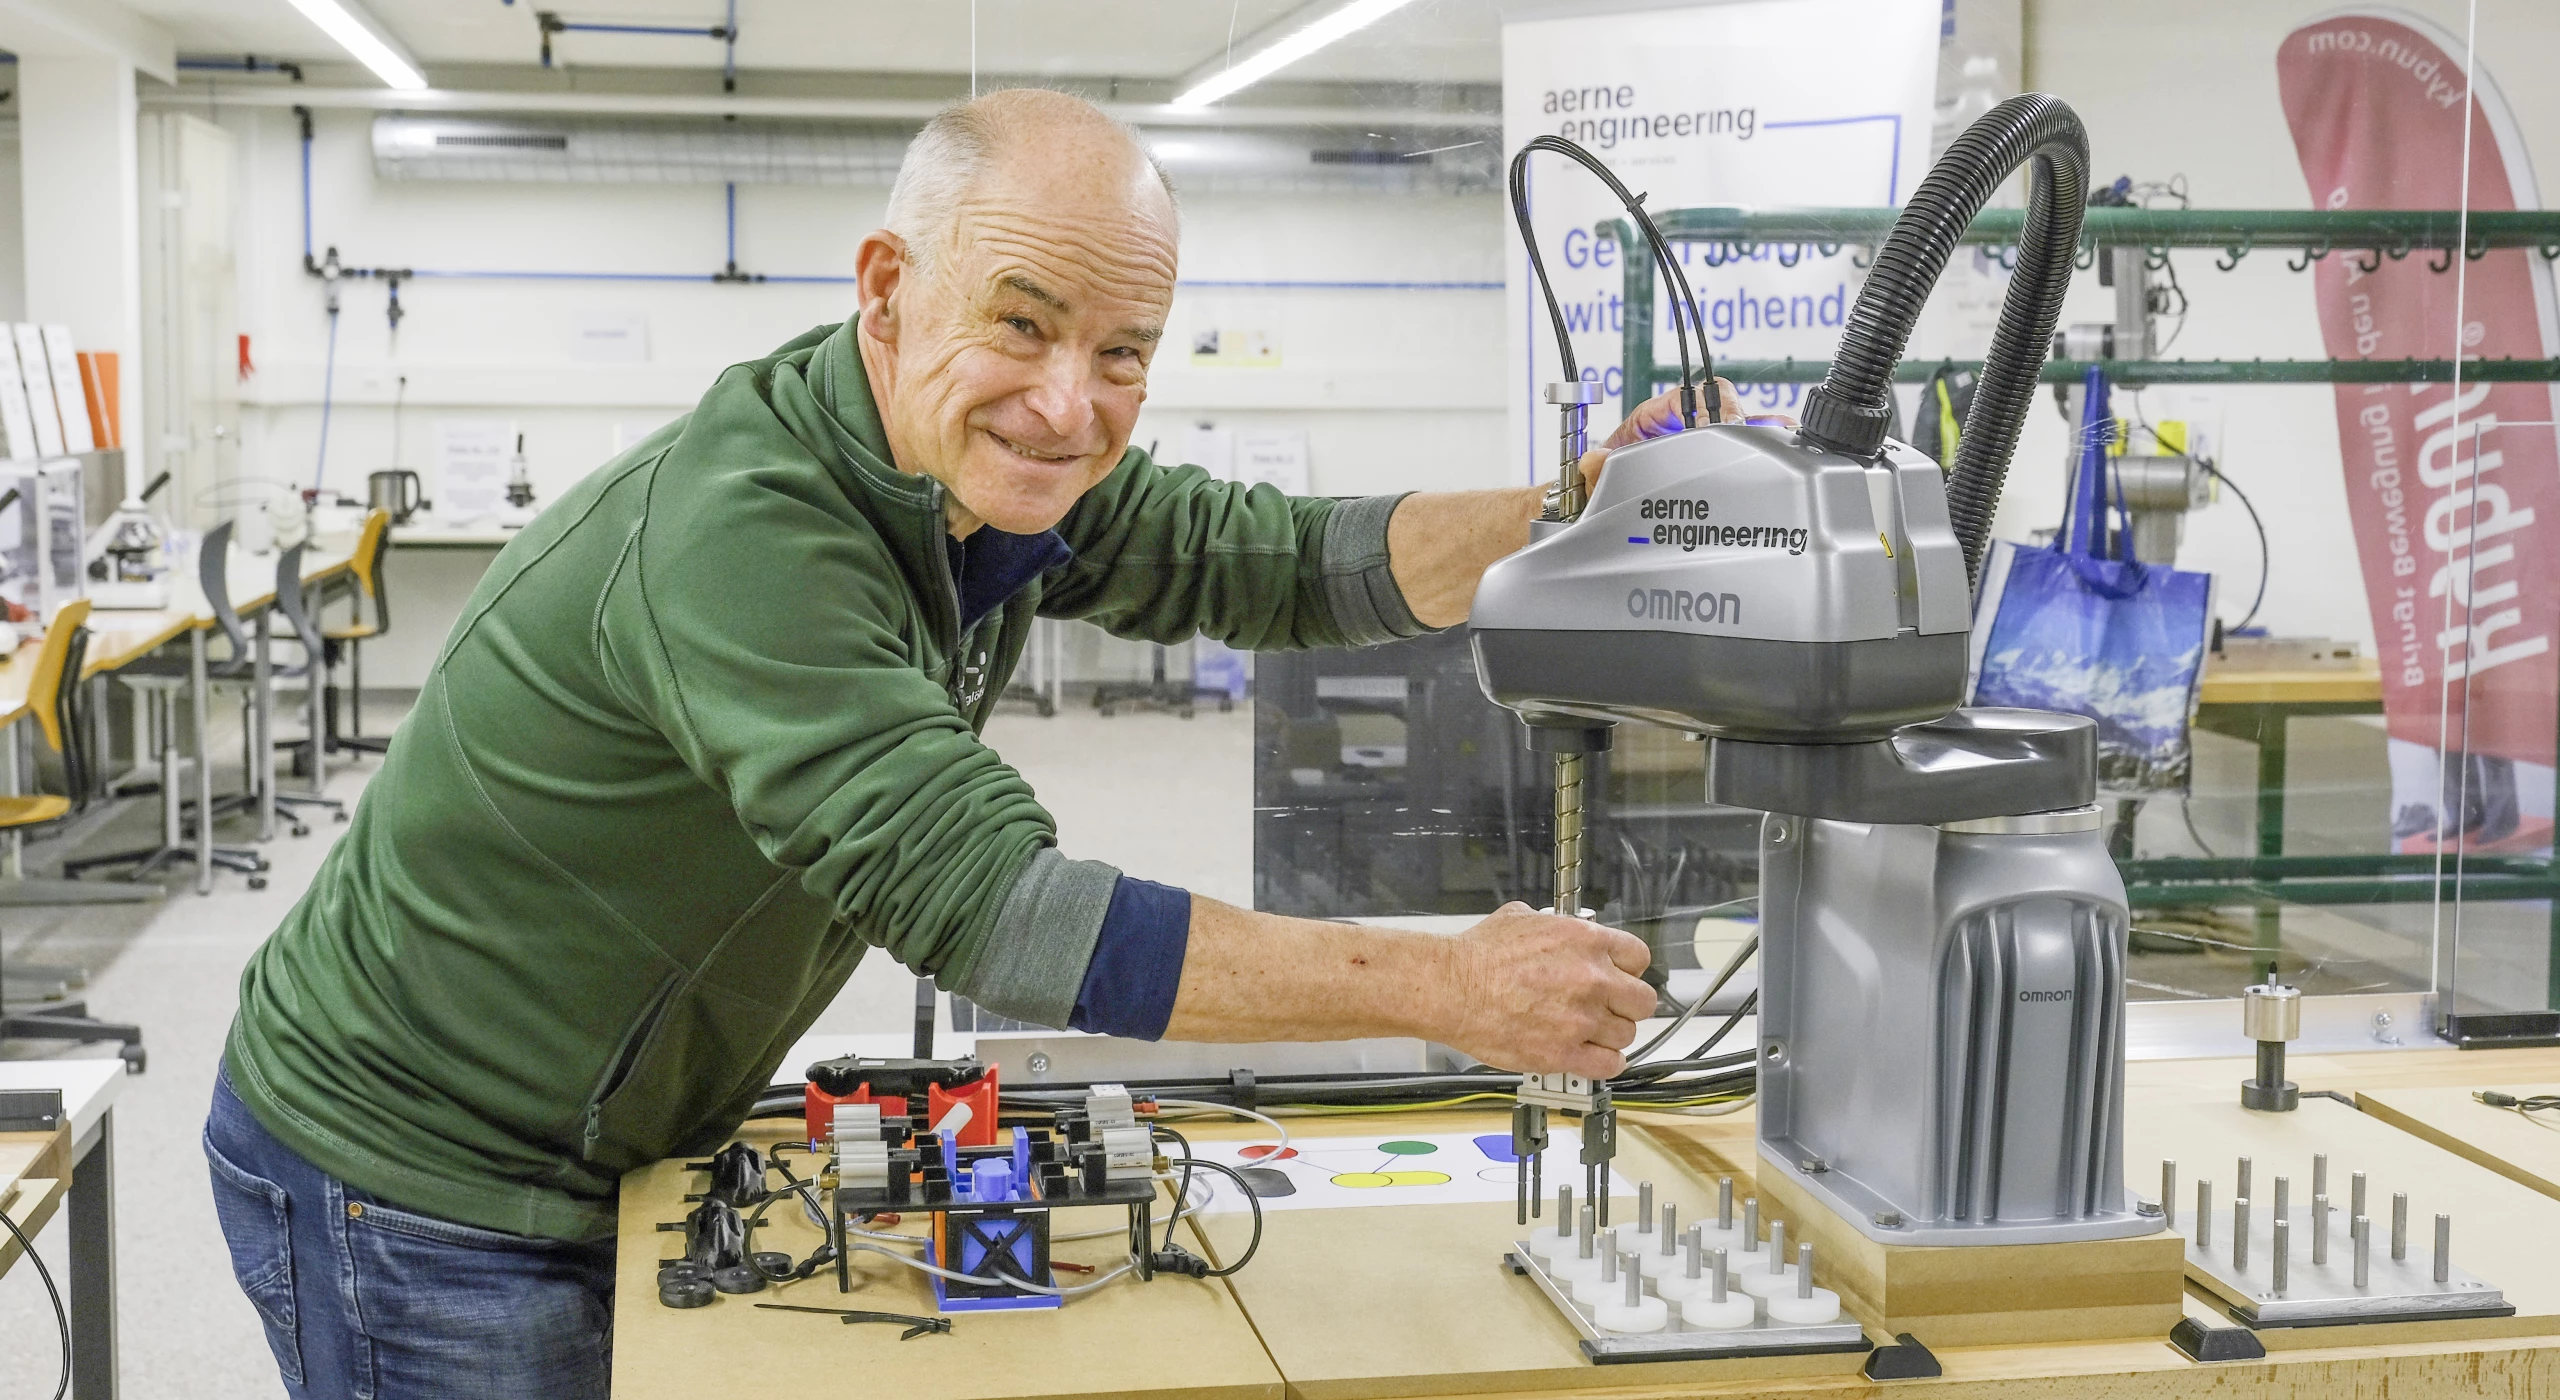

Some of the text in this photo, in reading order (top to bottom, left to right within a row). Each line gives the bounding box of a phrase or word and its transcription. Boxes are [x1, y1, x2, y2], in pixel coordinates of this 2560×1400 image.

[1543, 84, 1634, 114] aerne
[1560, 106, 1756, 149] engineering
[1563, 227, 1616, 270] Ge
[1563, 290, 1625, 333] wit
[1666, 283, 1846, 343] highend
[1640, 498, 1709, 520] aerne
[1653, 524, 1808, 556] engineering
[1627, 587, 1741, 625] OMRON
[2019, 990, 2072, 1003] OMRON
